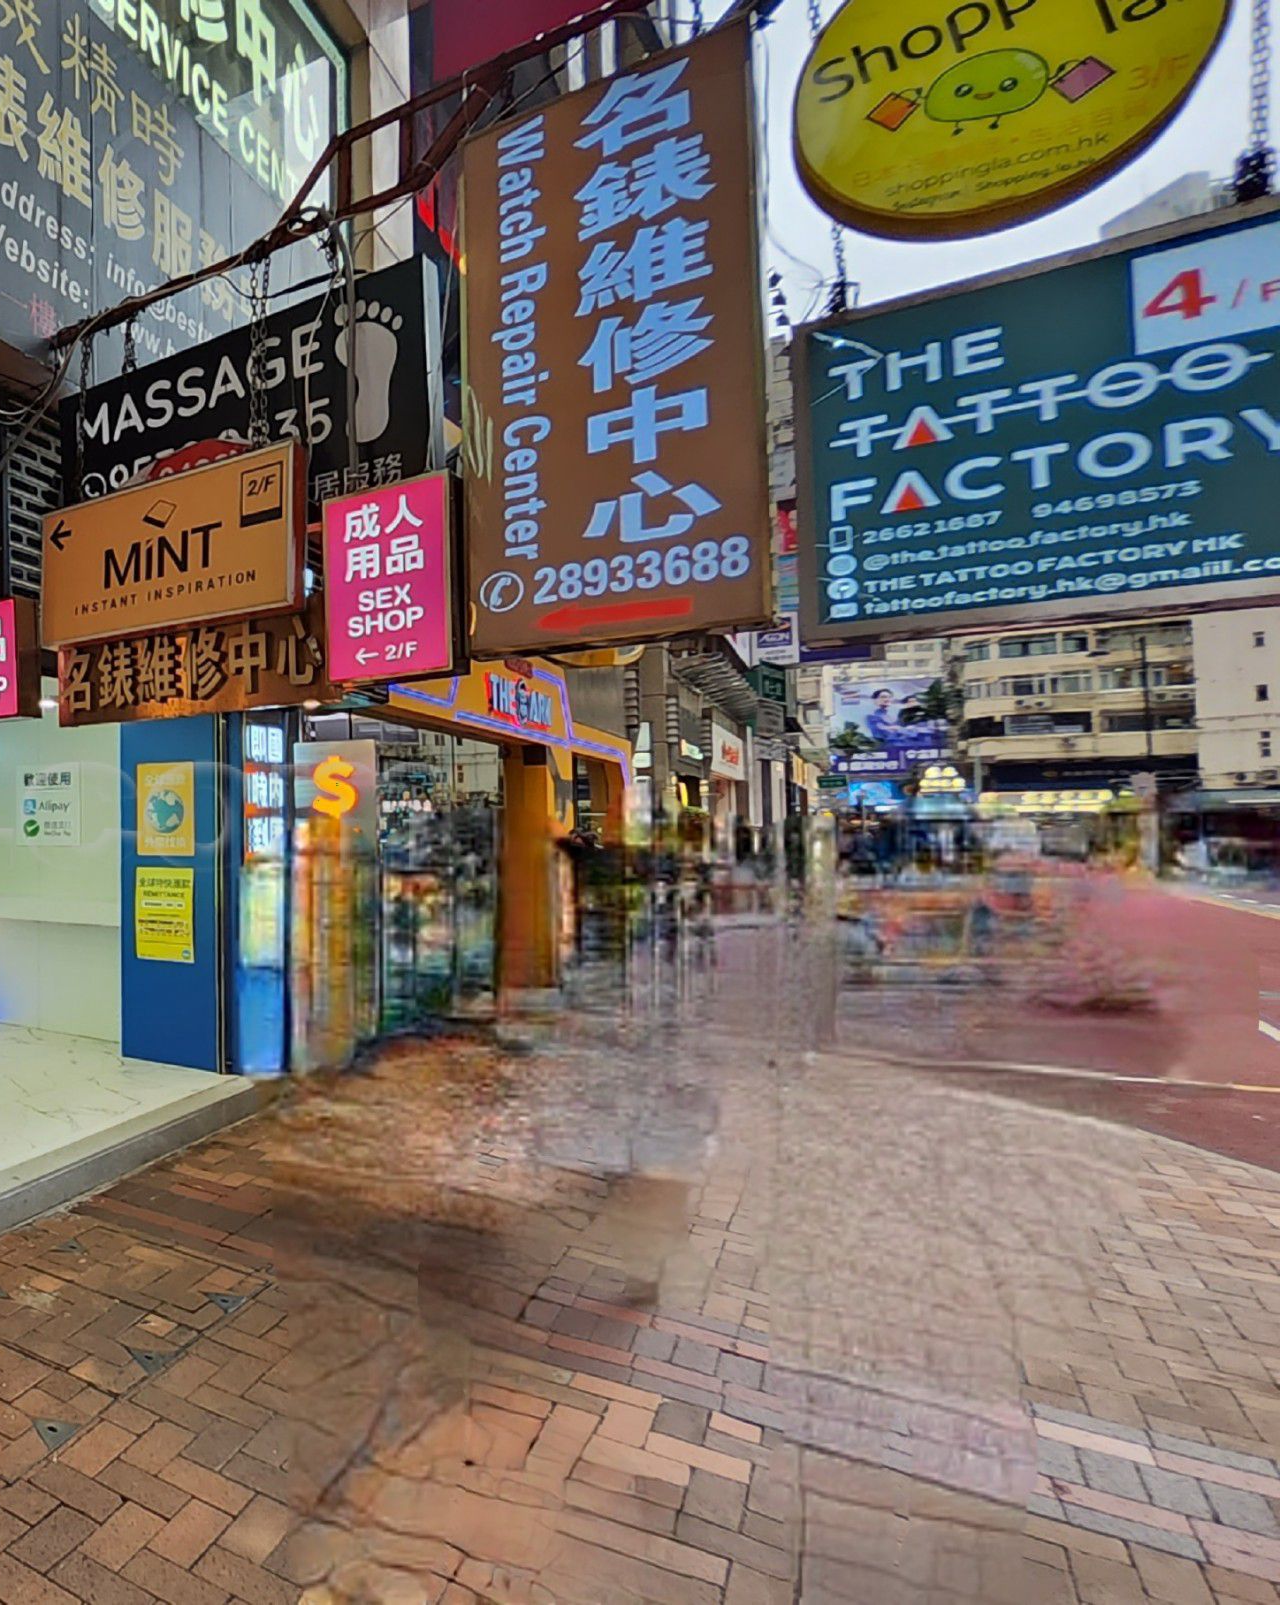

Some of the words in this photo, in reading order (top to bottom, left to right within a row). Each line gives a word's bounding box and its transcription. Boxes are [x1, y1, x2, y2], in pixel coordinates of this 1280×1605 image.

[497, 114, 546, 266] Watch
[573, 56, 722, 545] 名錶維修中心
[490, 263, 551, 407] Repair
[828, 327, 1005, 402] THE
[82, 321, 325, 446] MASSAGE
[830, 342, 1274, 460] TATTOO
[245, 475, 276, 498] 2/F
[343, 493, 424, 544] 成人
[500, 414, 552, 560] Center
[344, 535, 425, 583] 用品
[532, 536, 751, 605] 28933688
[863, 574, 919, 594] THE
[919, 560, 1033, 587] TATTOO
[1037, 540, 1190, 573] FACTORY
[1191, 532, 1248, 554] HK
[74, 593, 138, 616] INSTANT
[146, 568, 257, 604] INSPIRATION
[347, 605, 425, 638] SHOP
[357, 583, 412, 613] SEX
[62, 614, 317, 713] 名錶維修中心
[384, 640, 418, 661] 2/F
[39, 802, 71, 813] Alipay
